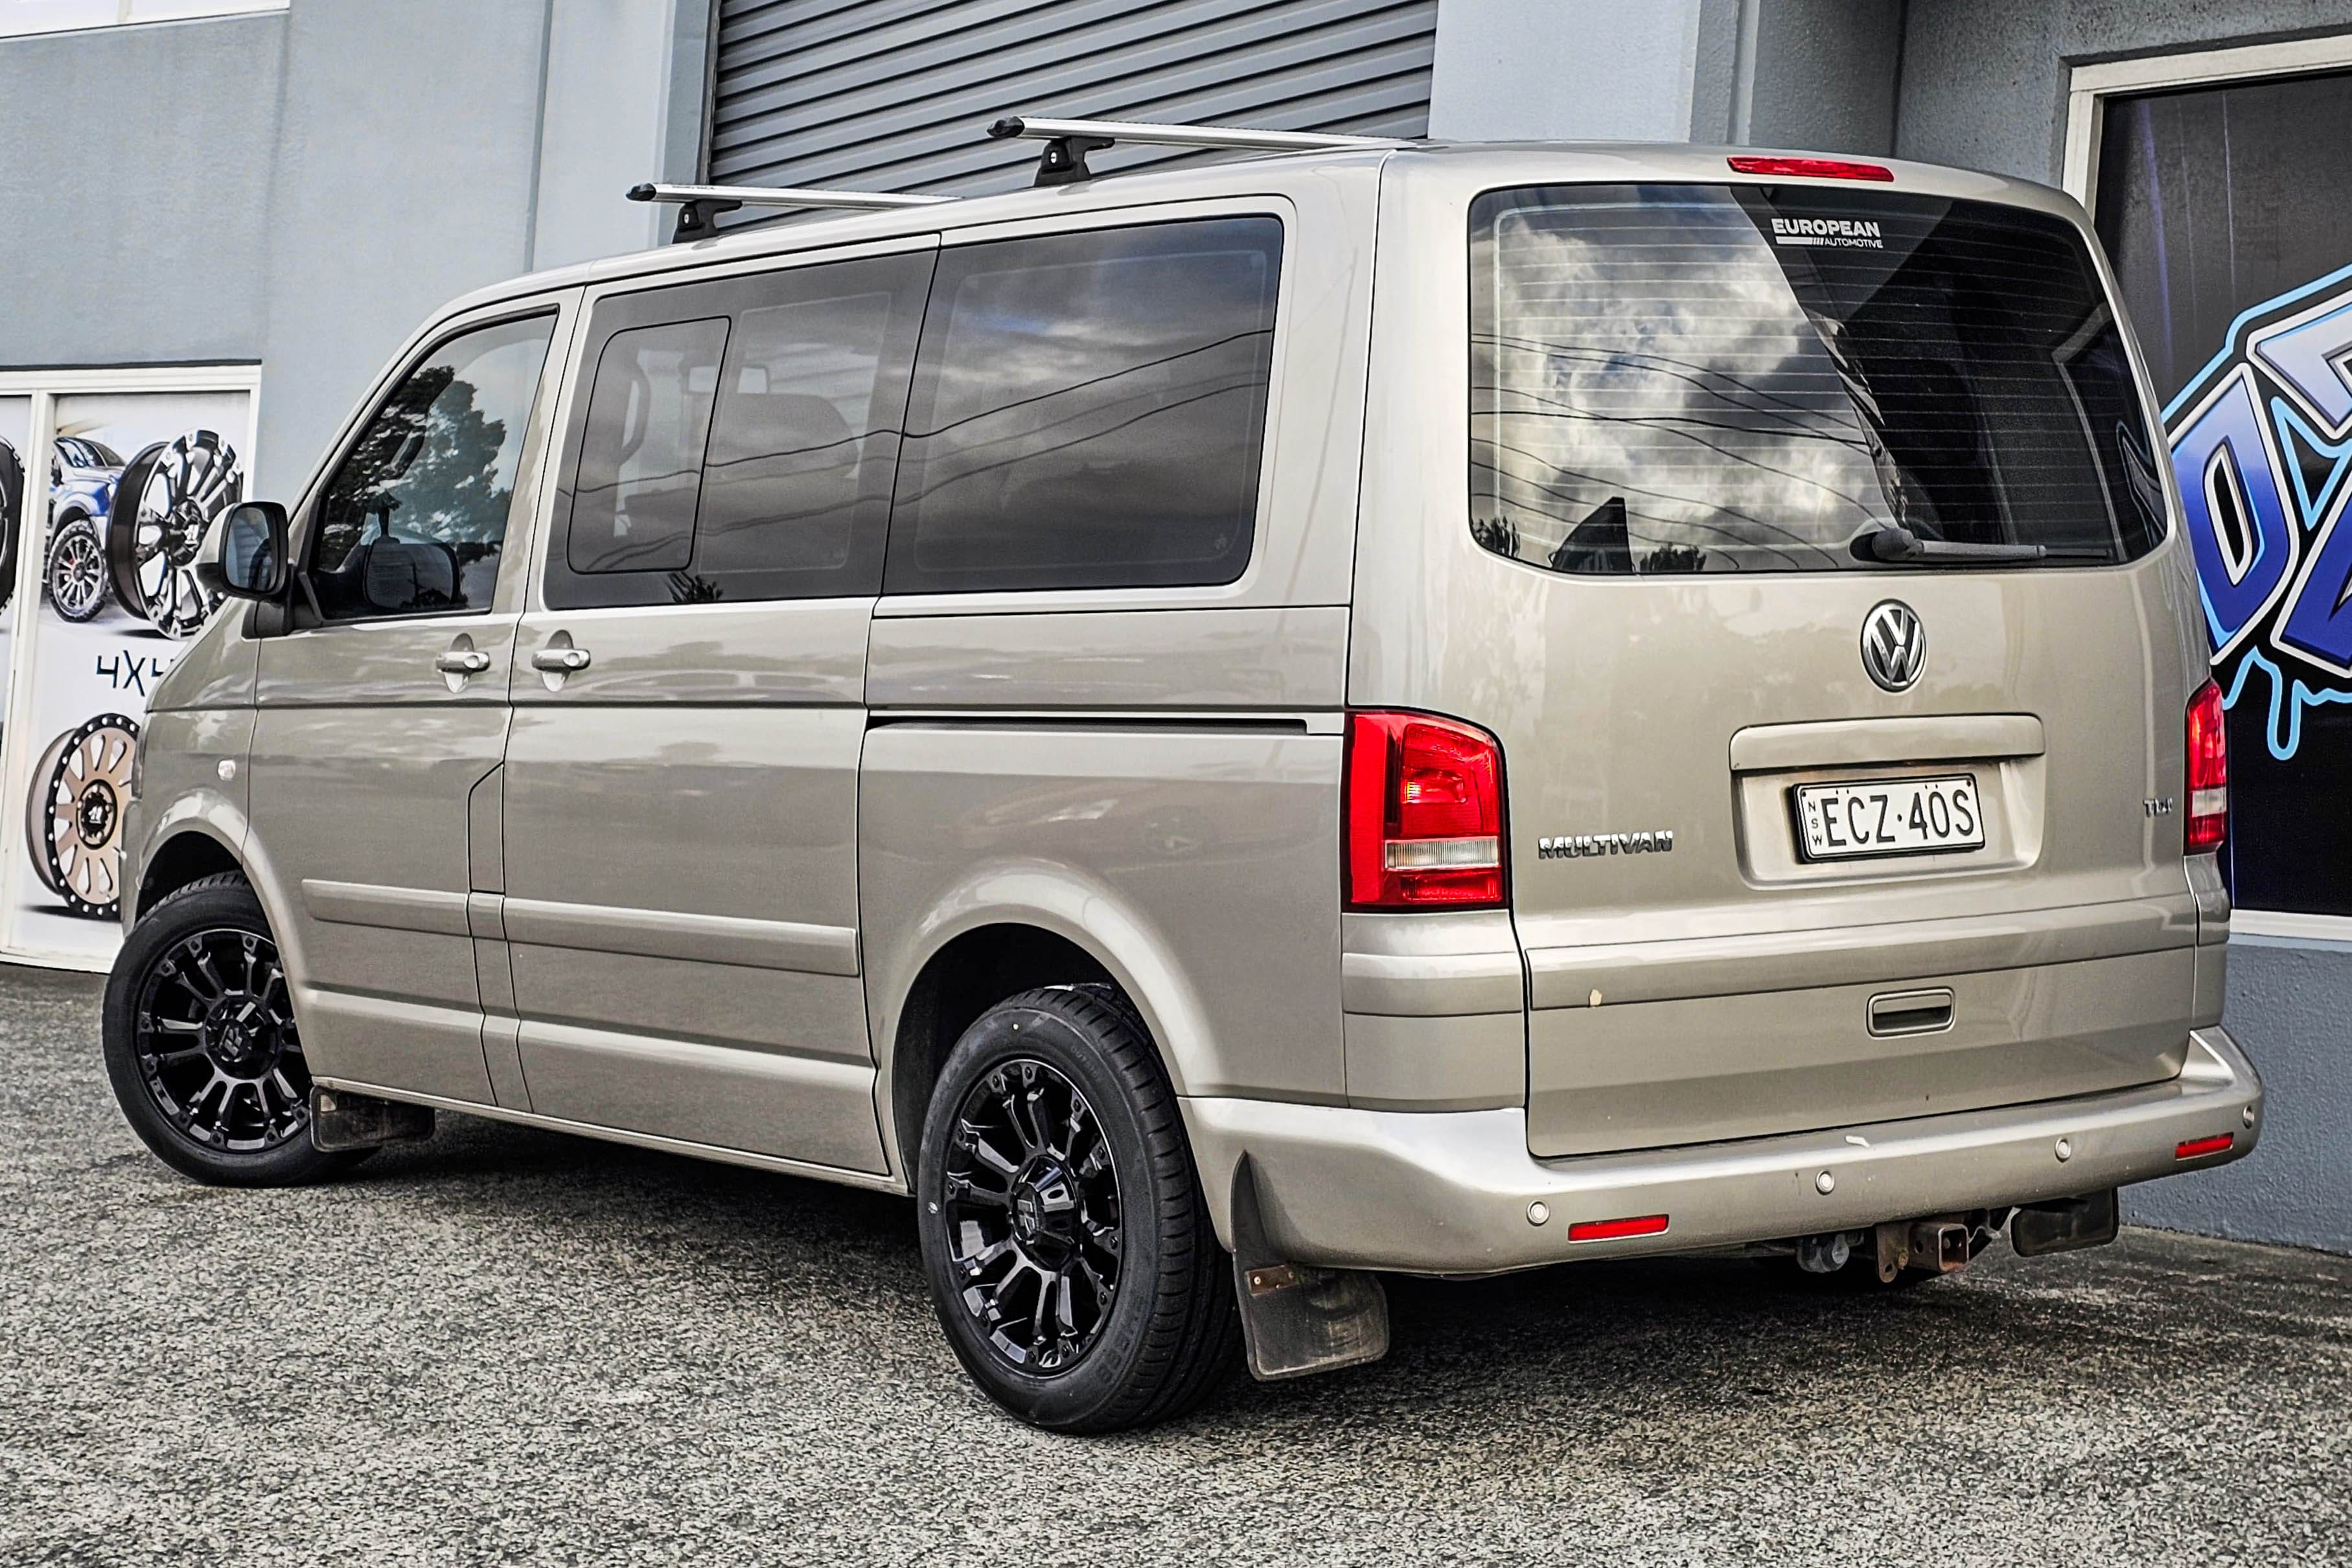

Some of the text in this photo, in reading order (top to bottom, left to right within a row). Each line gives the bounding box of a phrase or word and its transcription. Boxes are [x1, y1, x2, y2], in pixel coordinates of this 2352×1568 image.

[1771, 218, 1881, 237] EUROPEAN
[1825, 237, 1884, 249] AUTOMOTIVE
[1538, 830, 1674, 859] MULTIVAN
